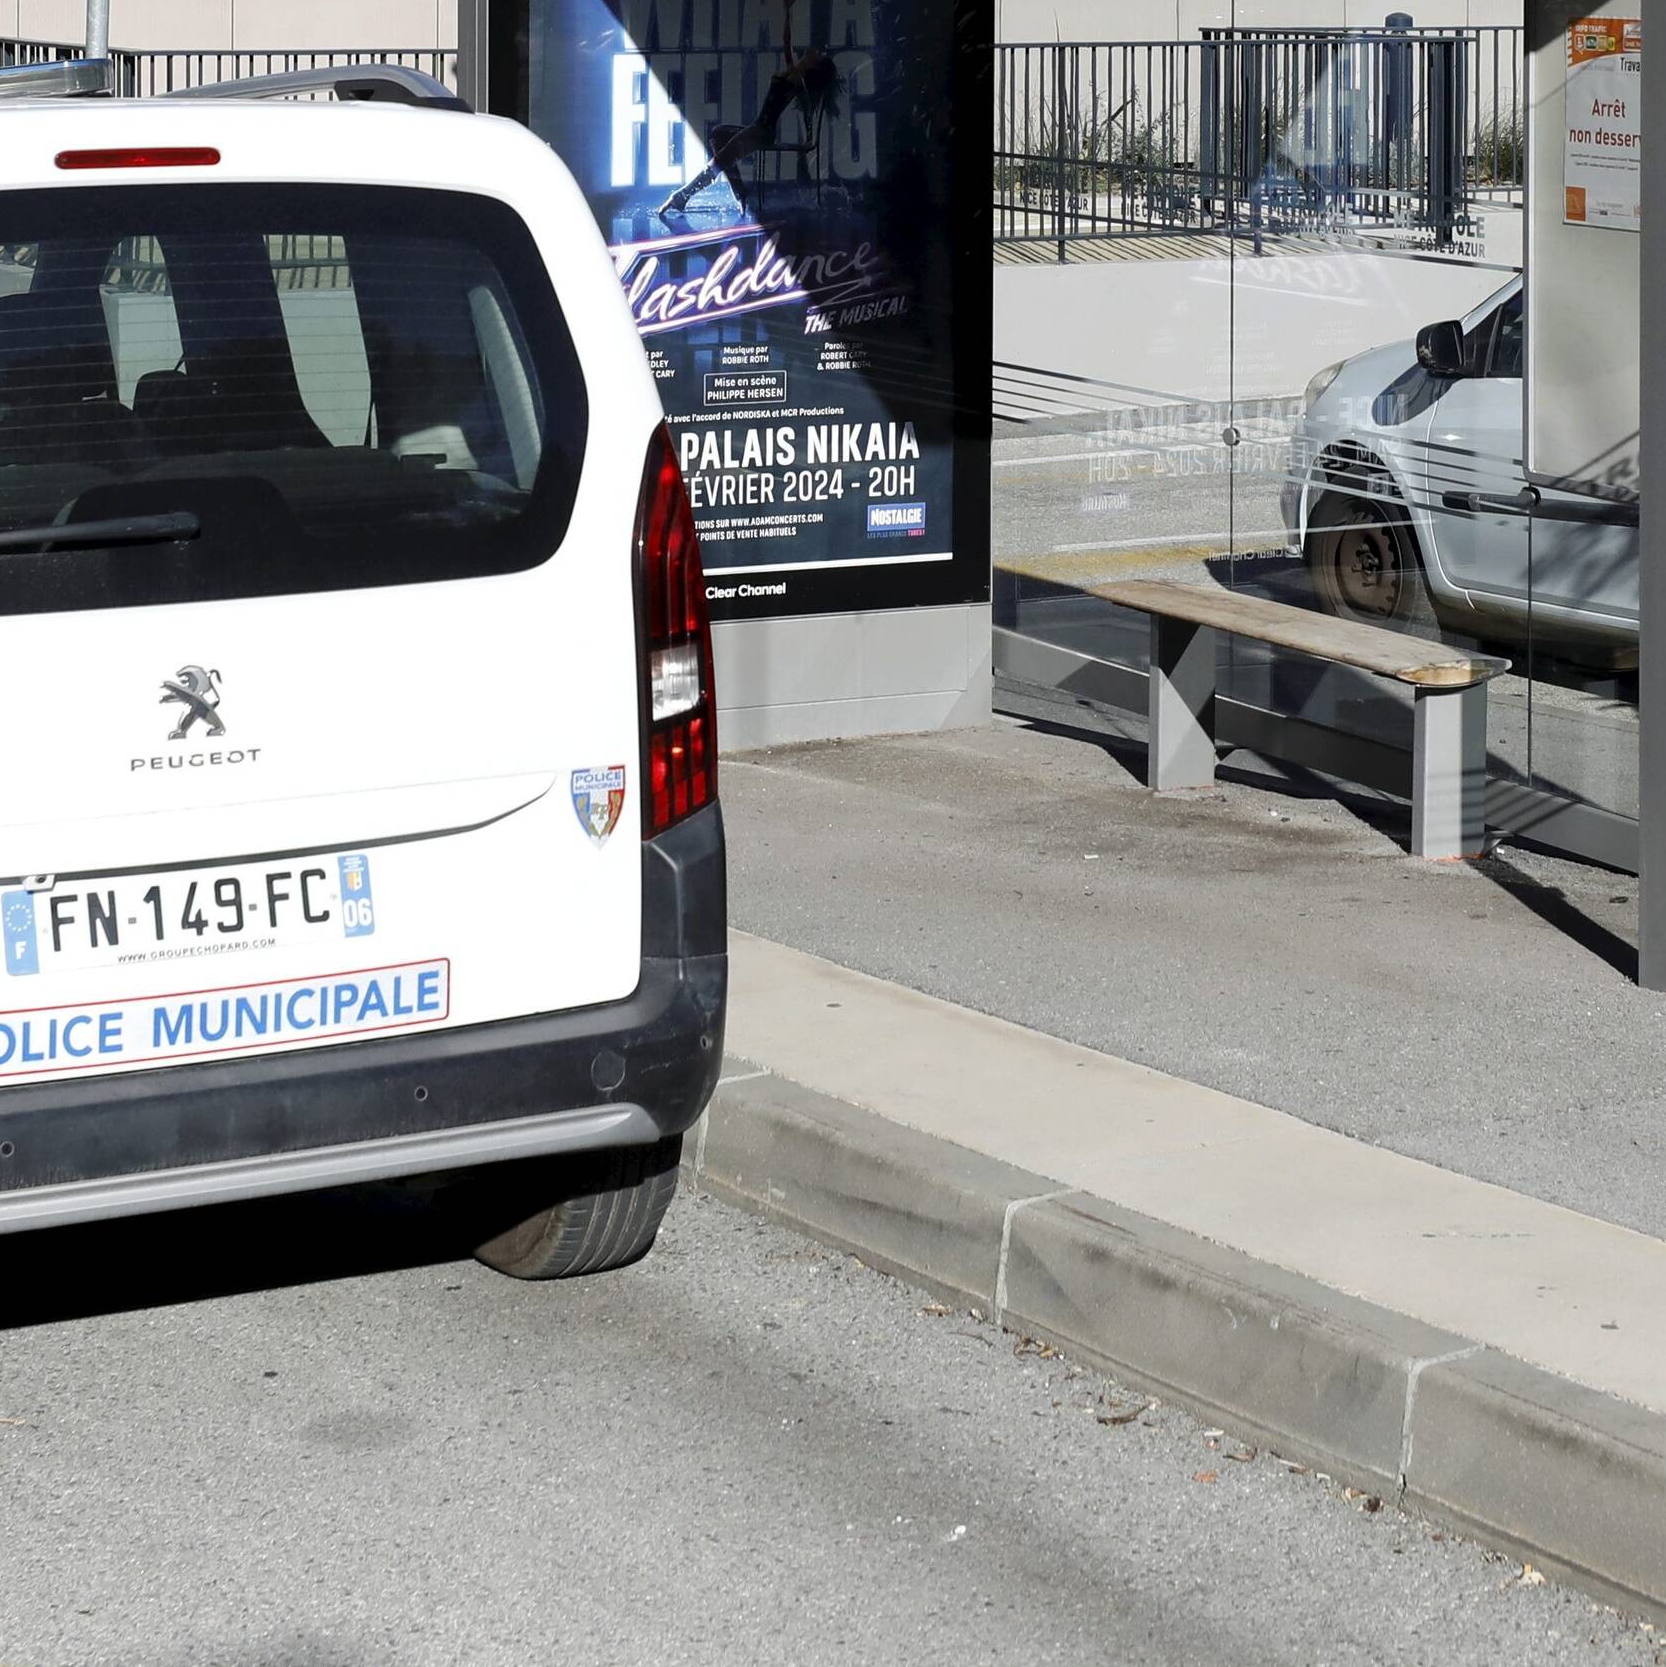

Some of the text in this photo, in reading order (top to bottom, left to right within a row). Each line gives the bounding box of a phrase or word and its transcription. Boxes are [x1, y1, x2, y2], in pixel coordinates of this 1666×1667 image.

[1620, 57, 1641, 72] Trava
[1592, 98, 1626, 118] Arrêt
[1569, 127, 1641, 148] non desser
[805, 296, 909, 335] THE MUSICAL
[650, 350, 663, 359] par
[723, 345, 768, 356] Musique par
[820, 351, 847, 360] ROBERT
[722, 355, 769, 364] ROBBIE ROTH
[825, 362, 851, 370] ROBBIE
[656, 370, 675, 378] CARY
[714, 375, 776, 387] Mise en scène
[707, 387, 783, 401] PHILIPPE HERSEN
[673, 414, 690, 423] avec
[692, 411, 720, 422] l'accord
[722, 410, 731, 420] de
[733, 409, 771, 420] NORDISKA
[772, 409, 779, 417] et
[781, 408, 798, 417] MCR
[799, 406, 844, 416] Productions
[680, 421, 920, 473] PALAIS NIKAIA
[782, 468, 844, 503] 2024
[868, 465, 915, 498] 20H
[716, 519, 730, 528] SUR
[731, 513, 823, 527] WWW.ADAMCONCERTS.COM
[870, 508, 922, 526] NOSTALGIE
[700, 531, 725, 541] POINTS
[726, 530, 735, 540] DE
[736, 529, 758, 539] VENTE
[759, 527, 796, 537] HABITUELS
[705, 582, 786, 599] Clear Channel
[131, 747, 262, 772] PEUGEOT
[575, 771, 621, 784] POLICE
[574, 781, 621, 791] MUNICIPALE
[15, 940, 28, 960] F
[343, 897, 373, 928] 06
[117, 938, 277, 964] WWW.GROUPECHOPARD.COM
[152, 970, 441, 1048] MUNICIPALE
